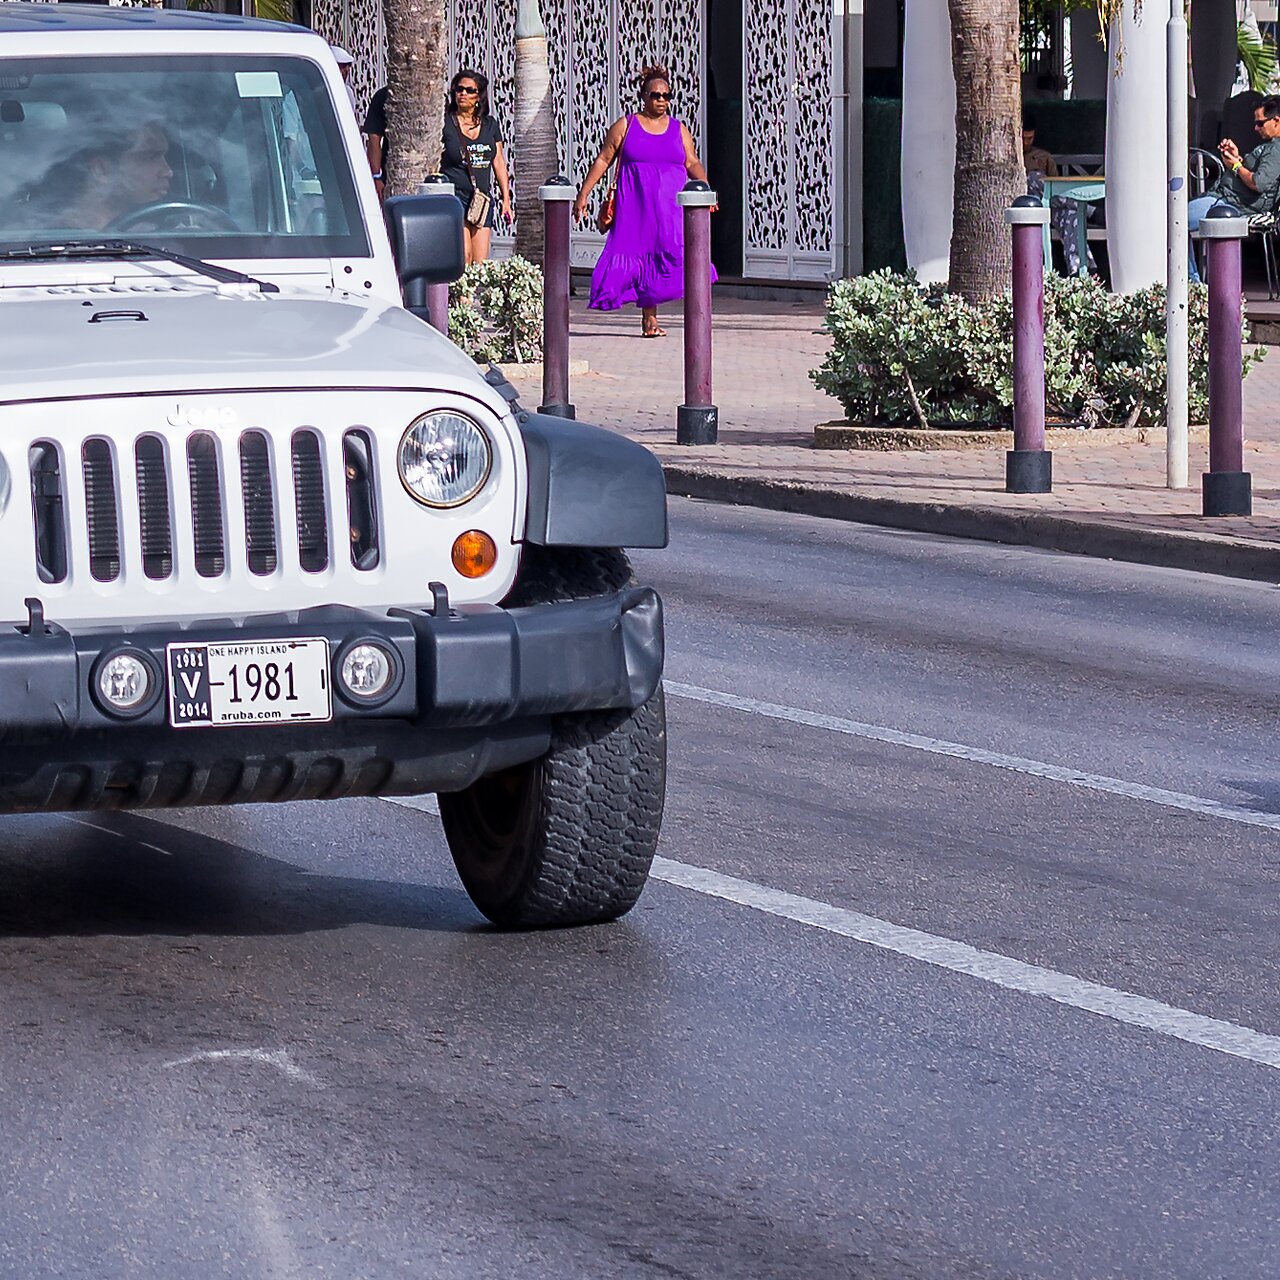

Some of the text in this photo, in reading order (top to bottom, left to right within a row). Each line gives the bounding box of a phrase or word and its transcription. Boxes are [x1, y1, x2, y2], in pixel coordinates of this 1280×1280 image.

[209, 644, 288, 657] ONE HAPPY ISLAND
[176, 652, 204, 669] 1981
[180, 671, 201, 699] V
[179, 701, 209, 718] 2014
[221, 709, 282, 721] aruba.com
